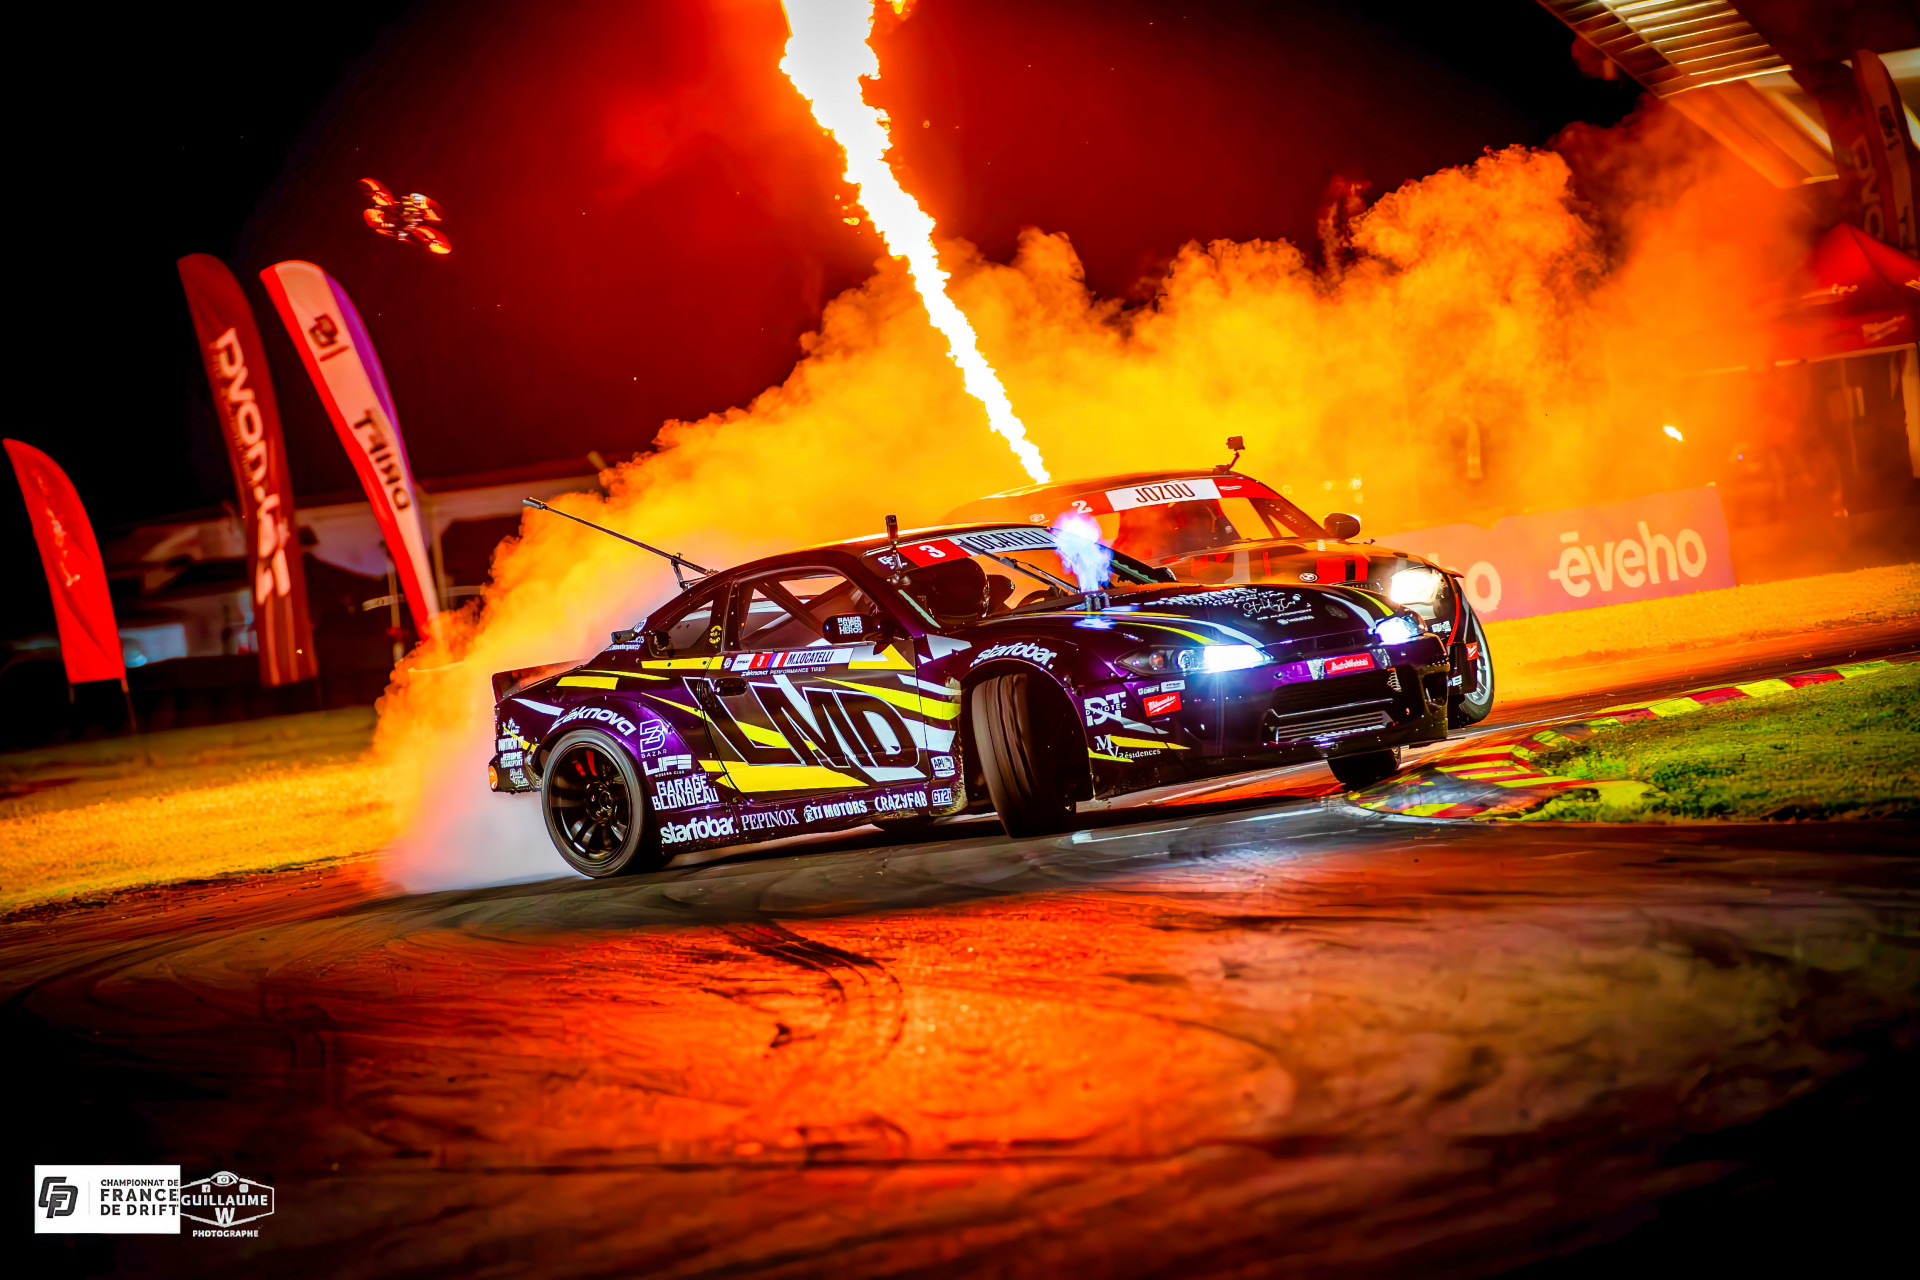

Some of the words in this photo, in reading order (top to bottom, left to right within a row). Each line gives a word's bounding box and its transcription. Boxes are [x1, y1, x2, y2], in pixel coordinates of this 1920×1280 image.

[1136, 483, 1196, 504] JOZOU
[1071, 500, 1093, 514] 2
[918, 544, 946, 558] 3
[957, 530, 1056, 550] OCATELLI
[756, 655, 765, 667] 3
[787, 651, 834, 665] M.LOCATELLI
[682, 675, 920, 768] LMD
[641, 748, 668, 759] BAZAR
[642, 754, 692, 776] LIFE
[656, 774, 709, 796] GARAGE
[651, 787, 720, 811] BLONDEAU
[824, 799, 868, 819] MOTORS
[874, 790, 929, 813] CRAZYFAB
[740, 808, 800, 831] PEPINOX
